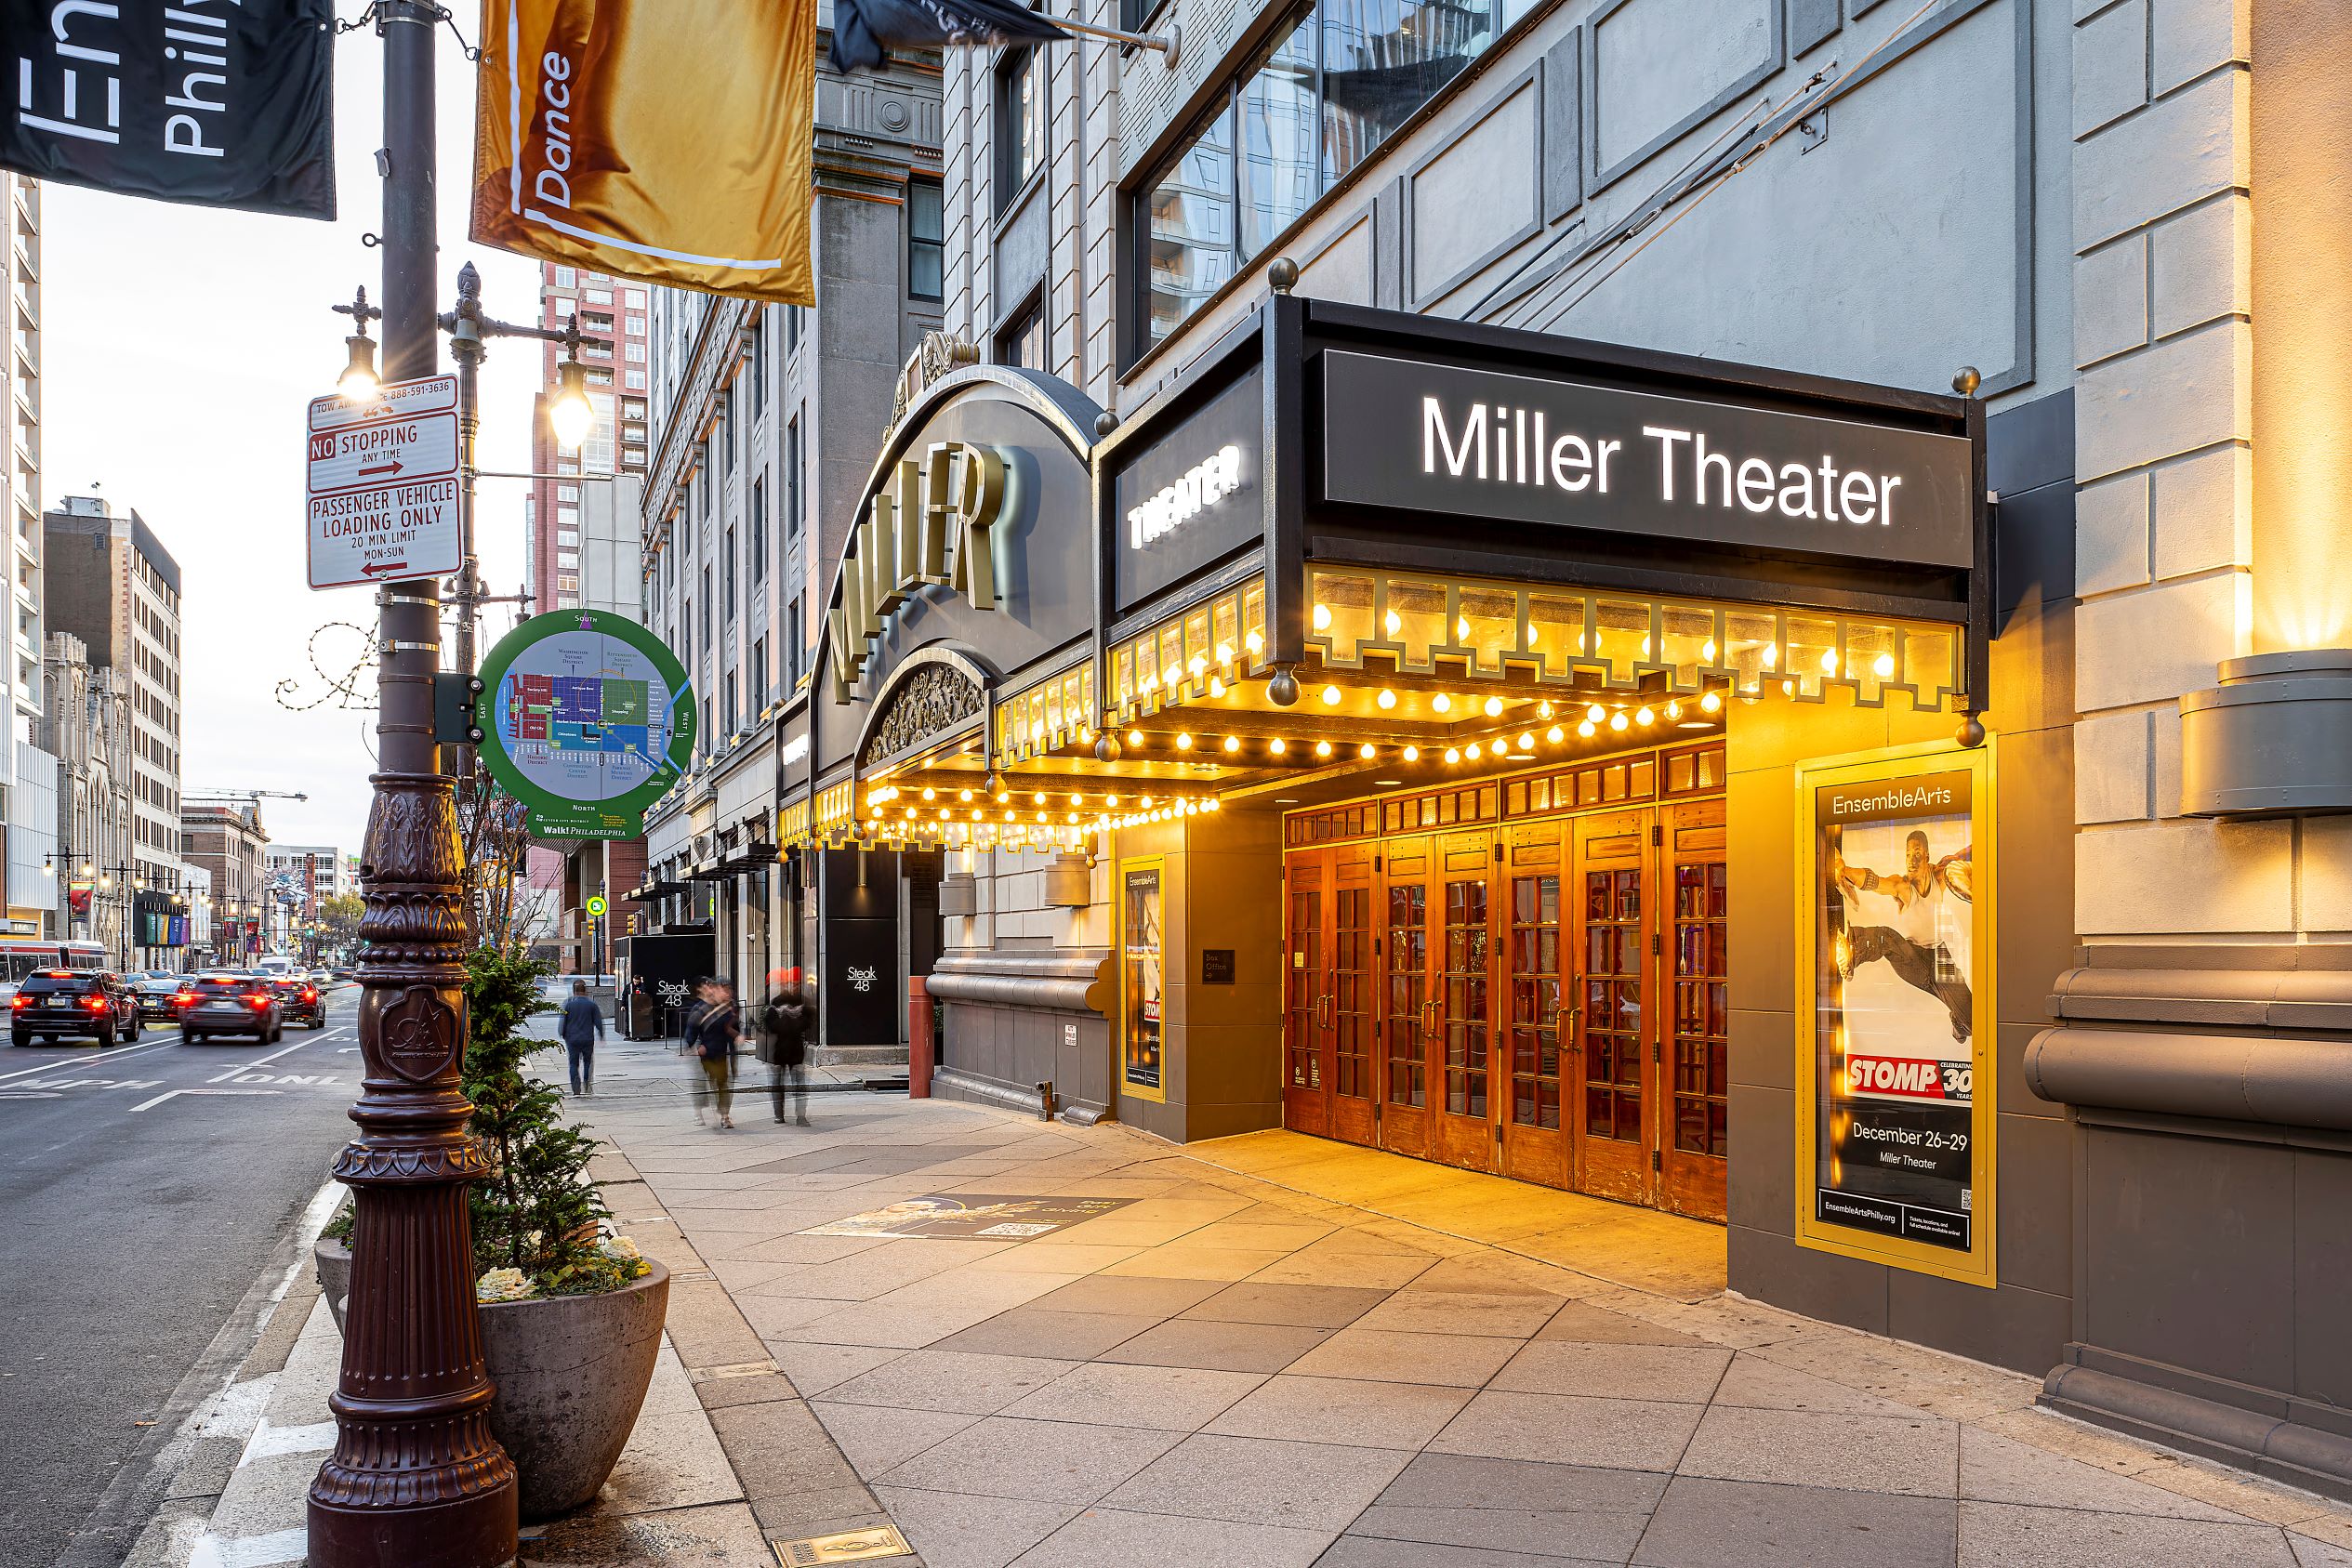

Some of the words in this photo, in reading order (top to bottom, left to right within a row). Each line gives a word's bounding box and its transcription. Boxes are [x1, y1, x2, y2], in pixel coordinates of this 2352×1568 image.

[165, 0, 241, 157] Phill
[535, 51, 571, 209] Dance
[317, 402, 335, 413] TOW
[390, 381, 450, 400] 888-591-3636
[311, 438, 335, 459] NO
[342, 425, 417, 454] STOPPING
[363, 452, 378, 463] ANY
[382, 449, 401, 460] TIME
[1421, 395, 1621, 494] Miller
[1643, 425, 1901, 526] Theater
[313, 491, 389, 519] PASSENGER
[397, 482, 453, 507] VEHICLE
[1127, 445, 1241, 549] THEATER
[324, 512, 391, 538] LOADING
[401, 506, 442, 527] ONLY
[351, 537, 363, 548] 20
[369, 534, 386, 547] MIN
[391, 530, 416, 544] LIMIT
[364, 547, 404, 560] MON-SUN
[1833, 786, 1951, 815] EnsembleArts
[570, 826, 626, 836] PHILADELPHIA
[848, 966, 877, 979] Steak
[658, 979, 690, 993] Steak
[854, 980, 870, 992] 48
[665, 994, 682, 1007] 48
[232, 1074, 346, 1086] ONL
[1849, 1059, 1937, 1093] STOMP
[1943, 1068, 1972, 1093] 30
[1853, 1122, 1923, 1145] December
[1880, 1152, 1901, 1165] Miller
[1903, 1154, 1936, 1169] Theater
[1825, 1201, 1896, 1224] EnsembleArtsPhilly.org
